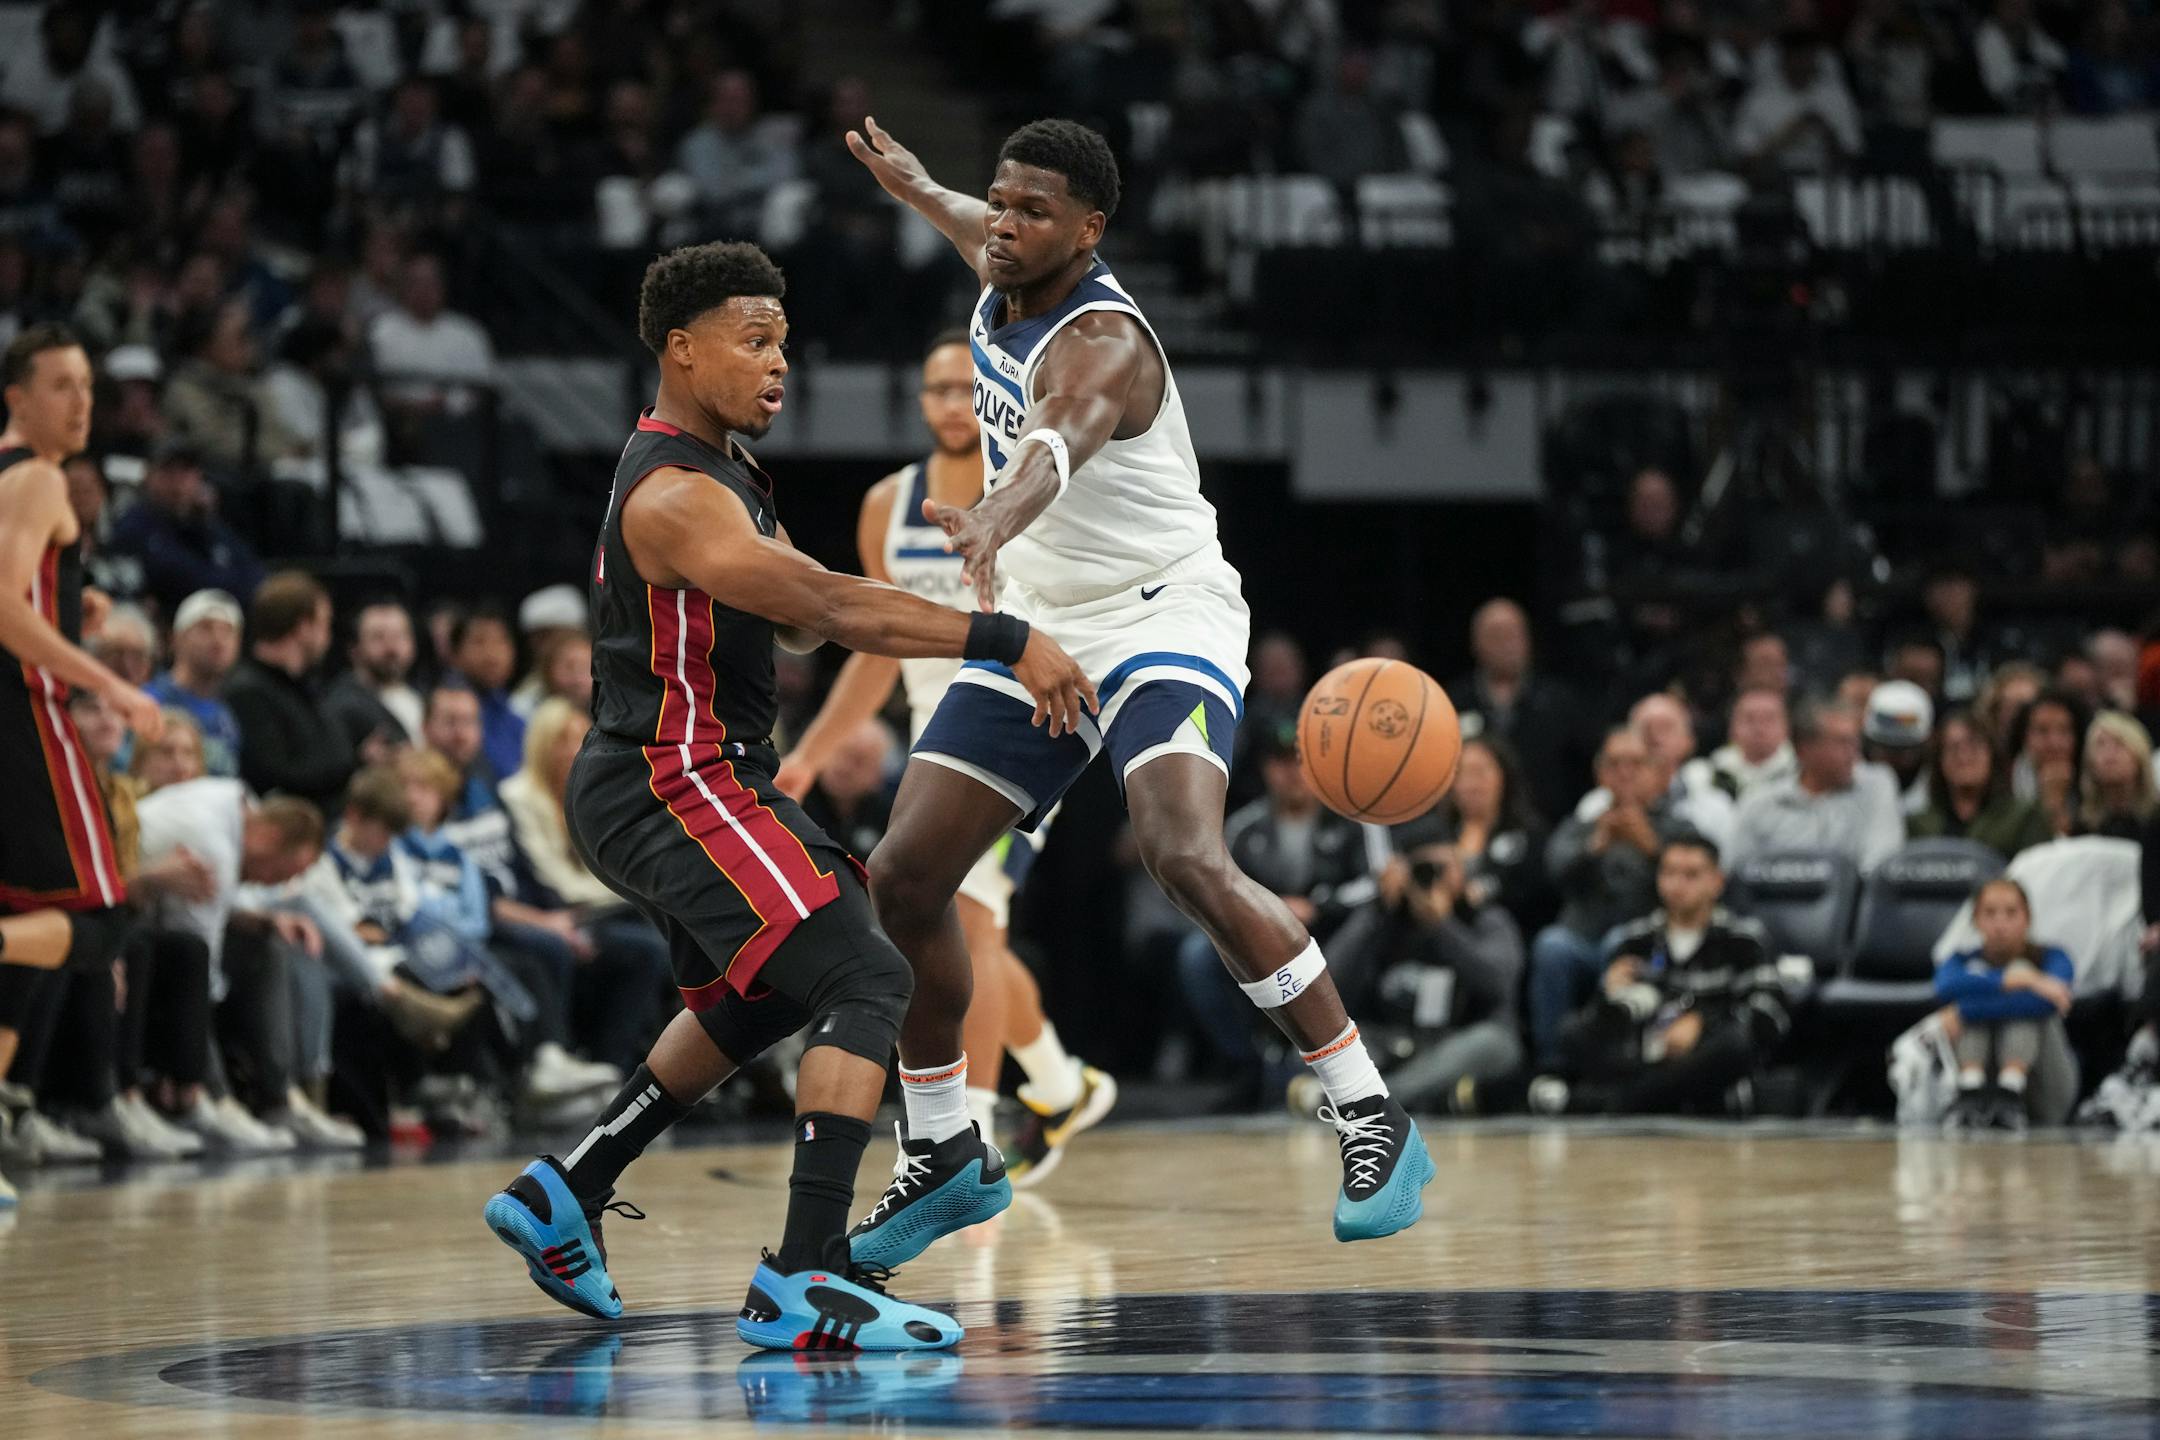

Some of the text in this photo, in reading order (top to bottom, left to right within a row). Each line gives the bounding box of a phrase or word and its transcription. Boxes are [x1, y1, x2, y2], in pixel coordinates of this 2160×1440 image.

[973, 377, 1025, 440] OLVE
[1276, 967, 1293, 987] 5
[1281, 978, 1305, 1002] AE
